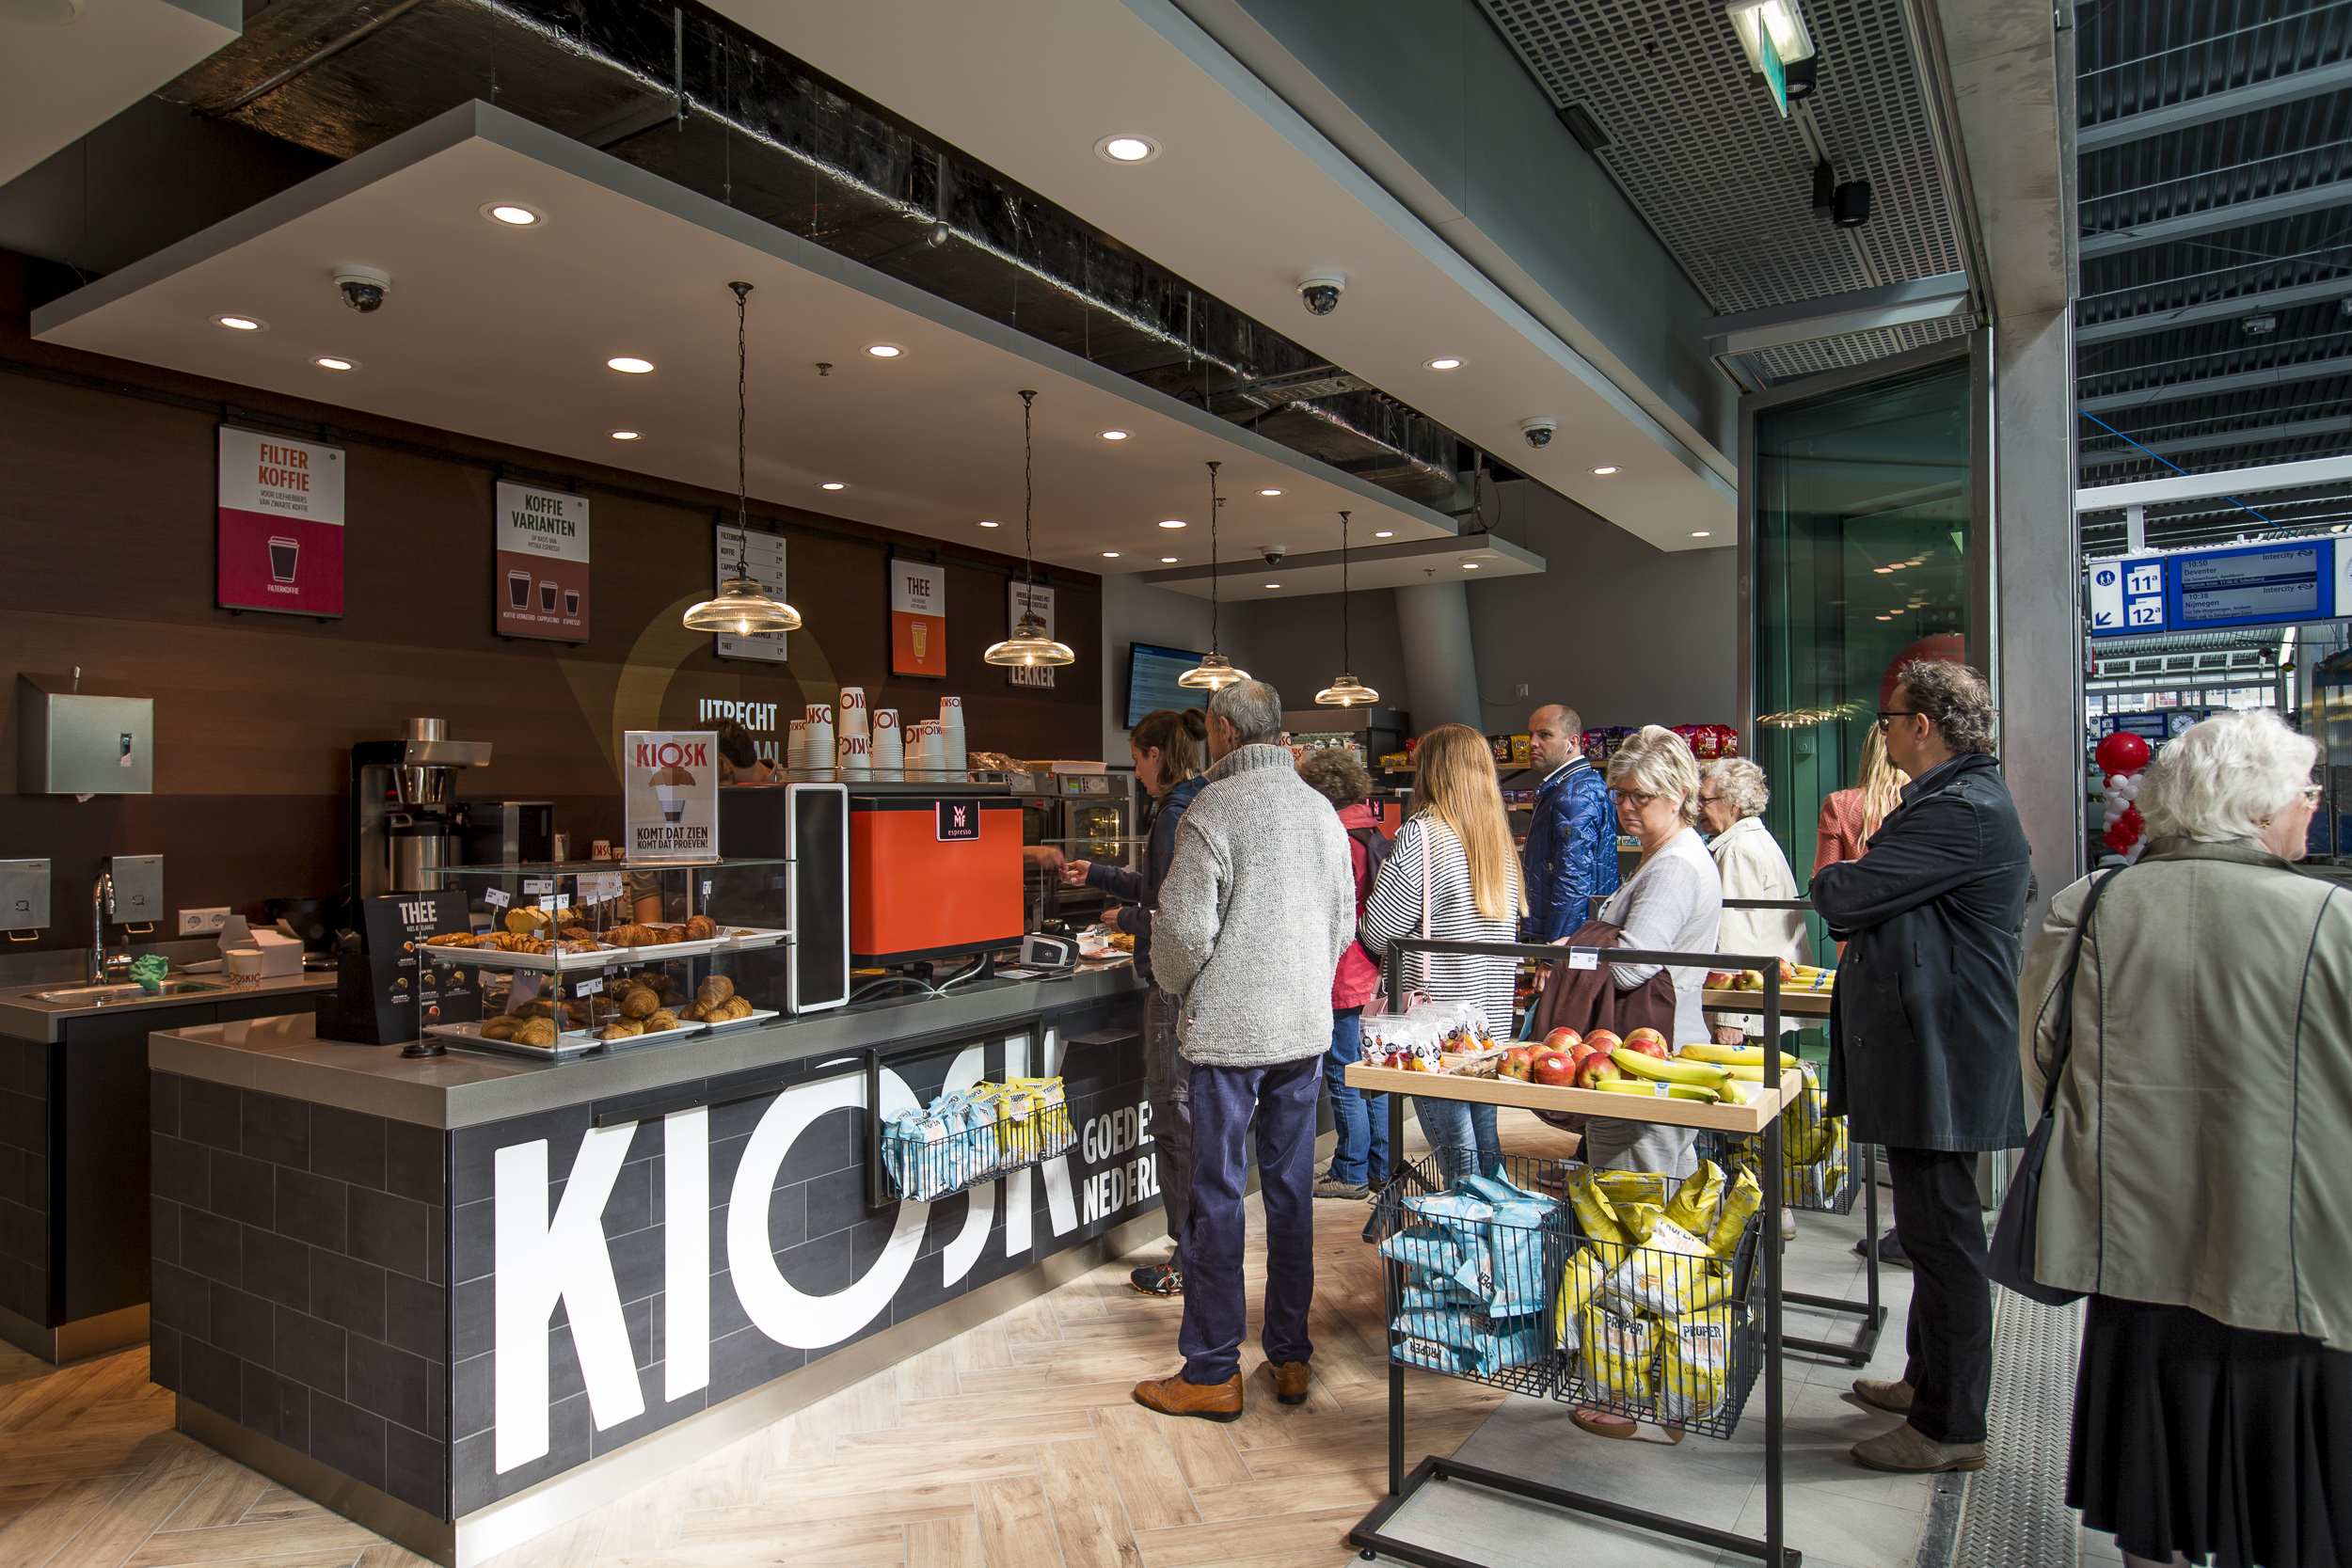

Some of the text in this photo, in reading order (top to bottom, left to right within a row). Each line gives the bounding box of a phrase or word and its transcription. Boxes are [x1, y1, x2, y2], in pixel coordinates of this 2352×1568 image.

[261, 443, 309, 469] FILTER
[259, 466, 310, 492] KOFFIE
[261, 489, 275, 498] VOOR
[525, 494, 564, 516] KOFFIE
[511, 511, 576, 537] VARIANTEN
[721, 547, 735, 556] KOFFIE
[2263, 552, 2294, 561] Intercity
[907, 577, 930, 597] THEE
[2263, 585, 2295, 594] Intercity
[2185, 600, 2219, 609] Nijmegen
[1011, 666, 1055, 687] LEKKER
[637, 742, 707, 768] KIOSK
[638, 827, 708, 840] KOMT DAT ZIEN
[638, 838, 708, 850] KOMT DAT PROEVEN!
[399, 900, 437, 925] THEE
[495, 1026, 1079, 1475] KIOSK
[1605, 1316, 1644, 1337] PROPER
[1682, 1324, 1723, 1338] PROPER
[1602, 1326, 1642, 1352] CORN
[1683, 1336, 1723, 1357] CORN
